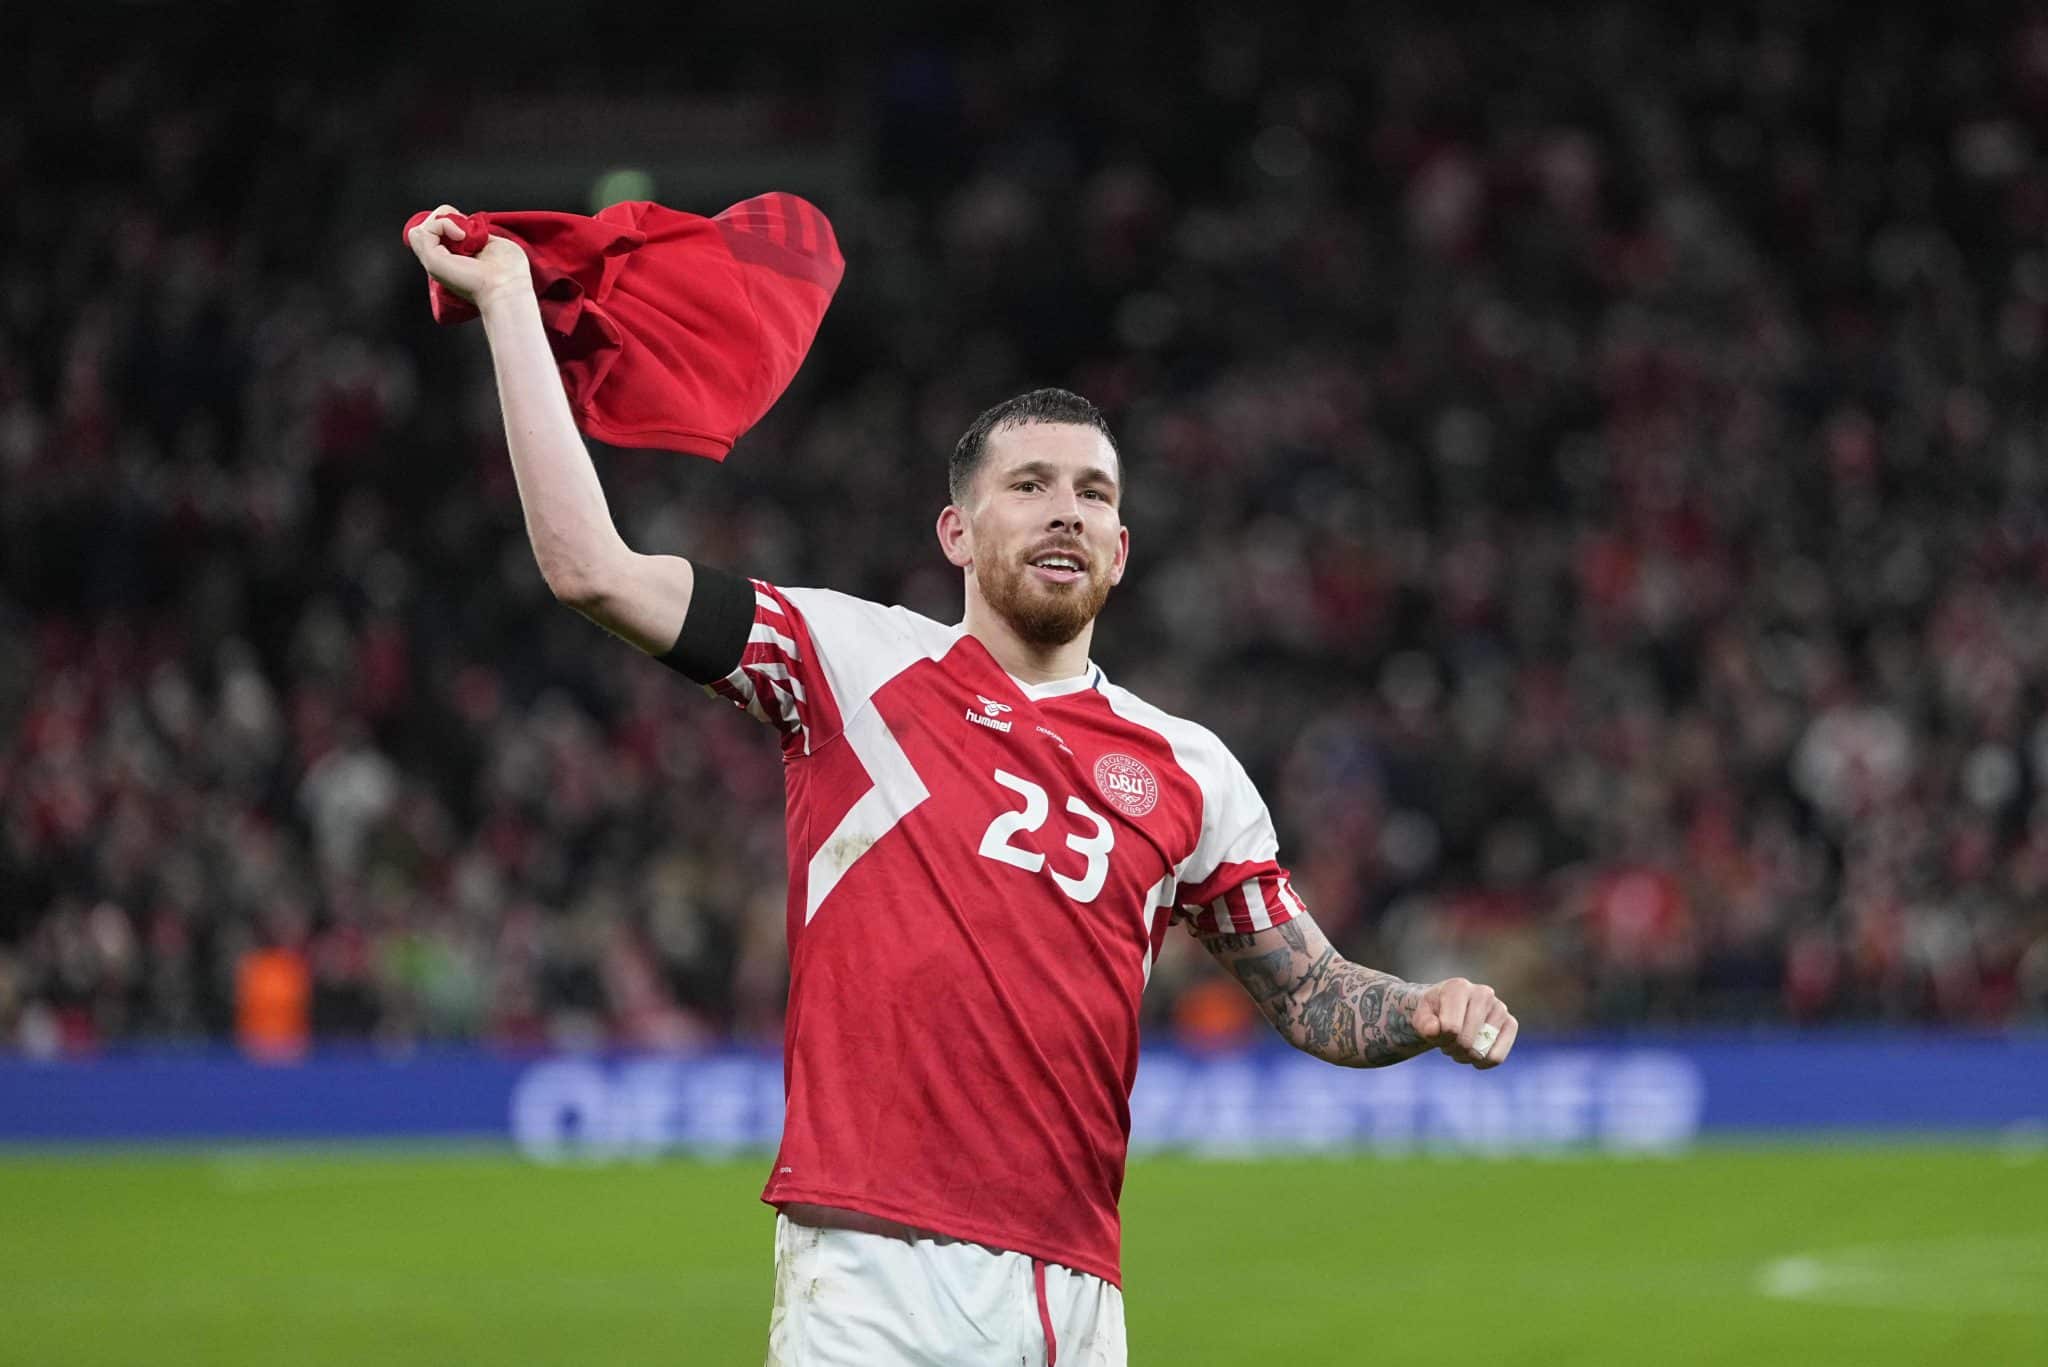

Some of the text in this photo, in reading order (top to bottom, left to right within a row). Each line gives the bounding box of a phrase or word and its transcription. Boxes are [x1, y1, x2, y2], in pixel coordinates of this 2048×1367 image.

[965, 708, 1012, 733] hummel
[1108, 773, 1144, 795] DBU
[977, 768, 1115, 903] 23
